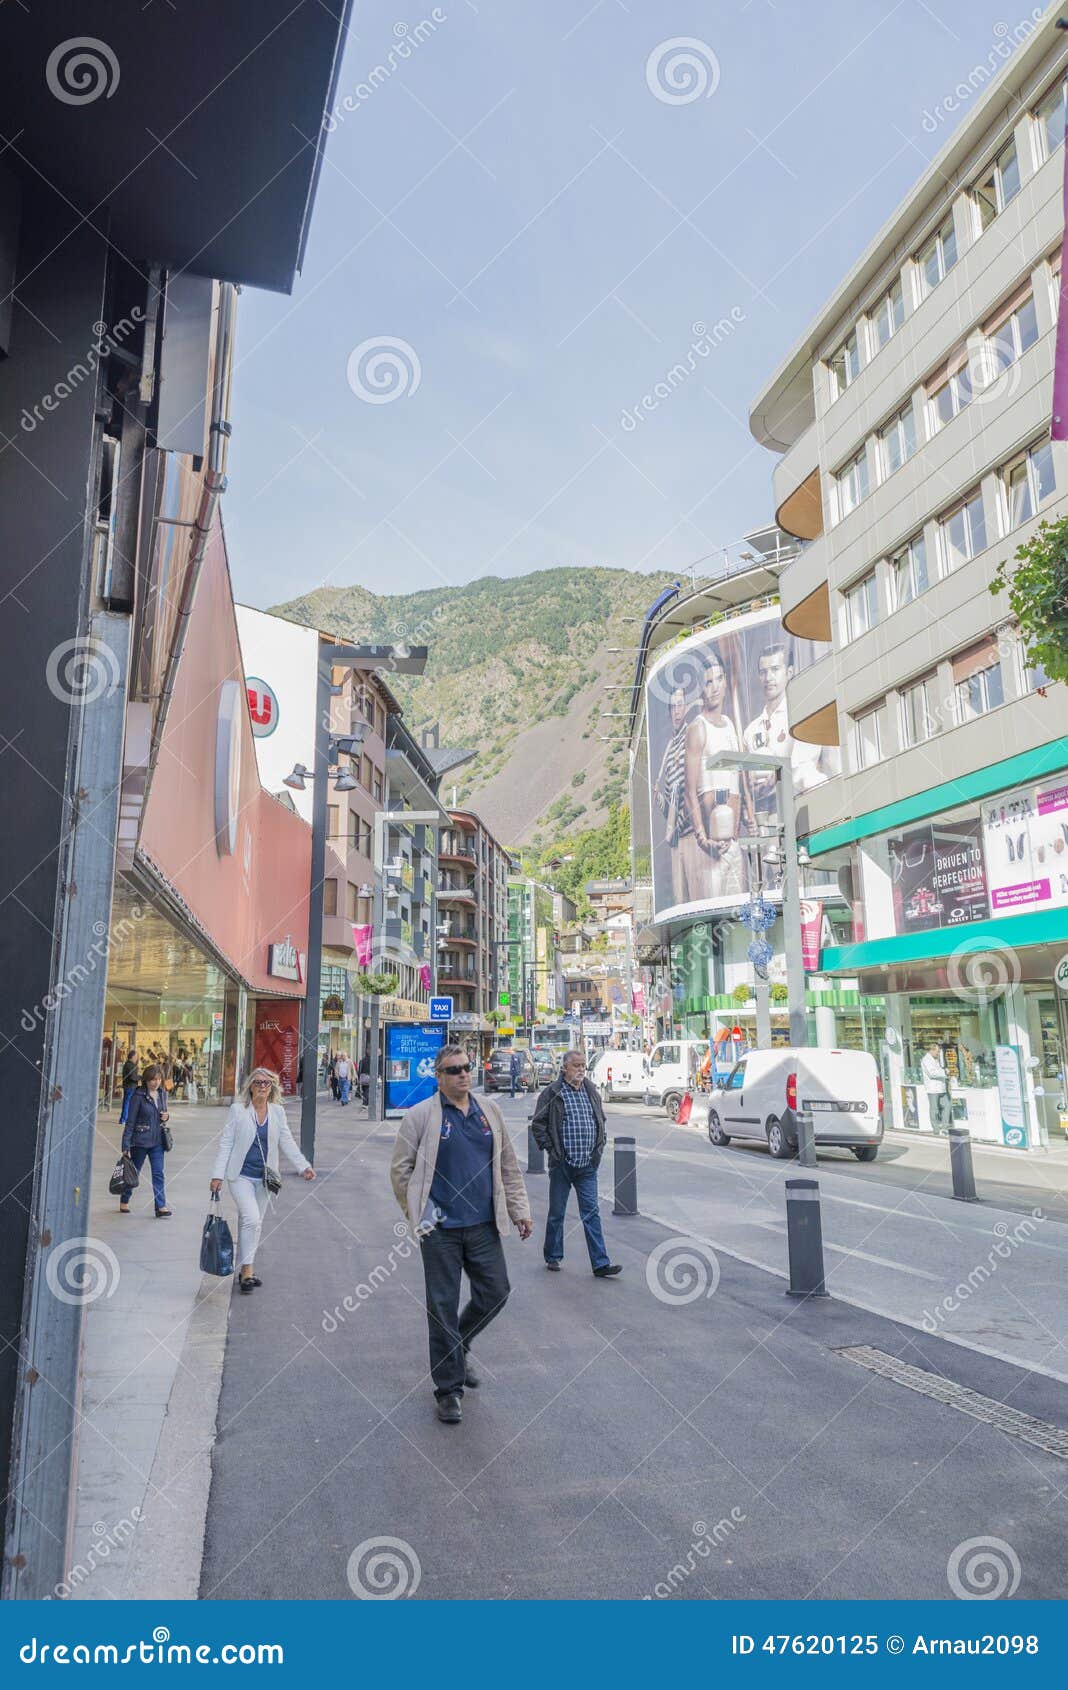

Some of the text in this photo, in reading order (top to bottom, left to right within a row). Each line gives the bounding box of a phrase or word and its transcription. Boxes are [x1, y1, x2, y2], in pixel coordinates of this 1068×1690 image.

[248, 689, 271, 725] U
[937, 849, 981, 871] DRIVEN TO
[932, 866, 983, 889] PERFECTION
